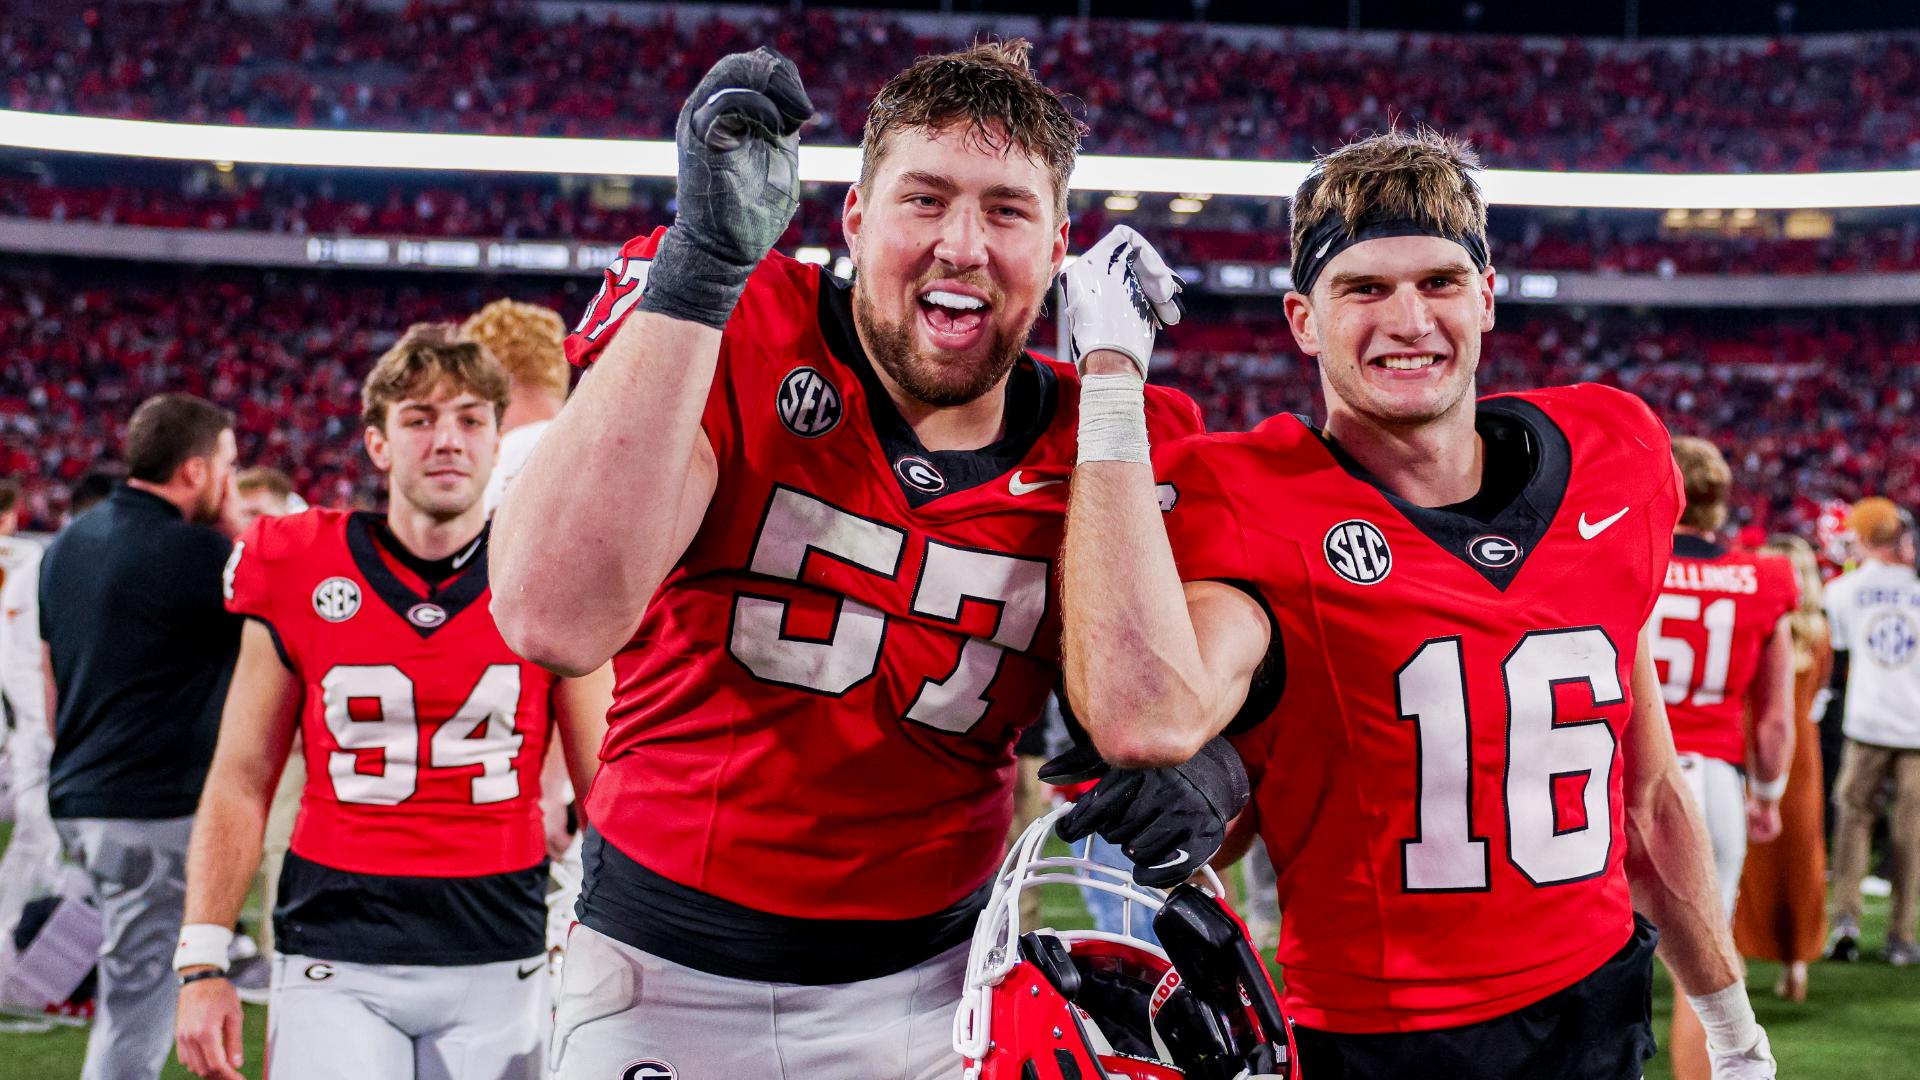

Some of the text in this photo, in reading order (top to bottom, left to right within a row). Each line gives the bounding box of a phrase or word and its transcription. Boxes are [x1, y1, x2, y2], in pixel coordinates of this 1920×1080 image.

[781, 370, 838, 434] SEC
[1329, 523, 1388, 581] SEC
[315, 579, 359, 619] SEC
[727, 482, 1049, 735] 57
[1648, 593, 1736, 705] 51
[320, 663, 524, 806] 94
[1394, 625, 1625, 893] 16
[304, 963, 335, 980] G
